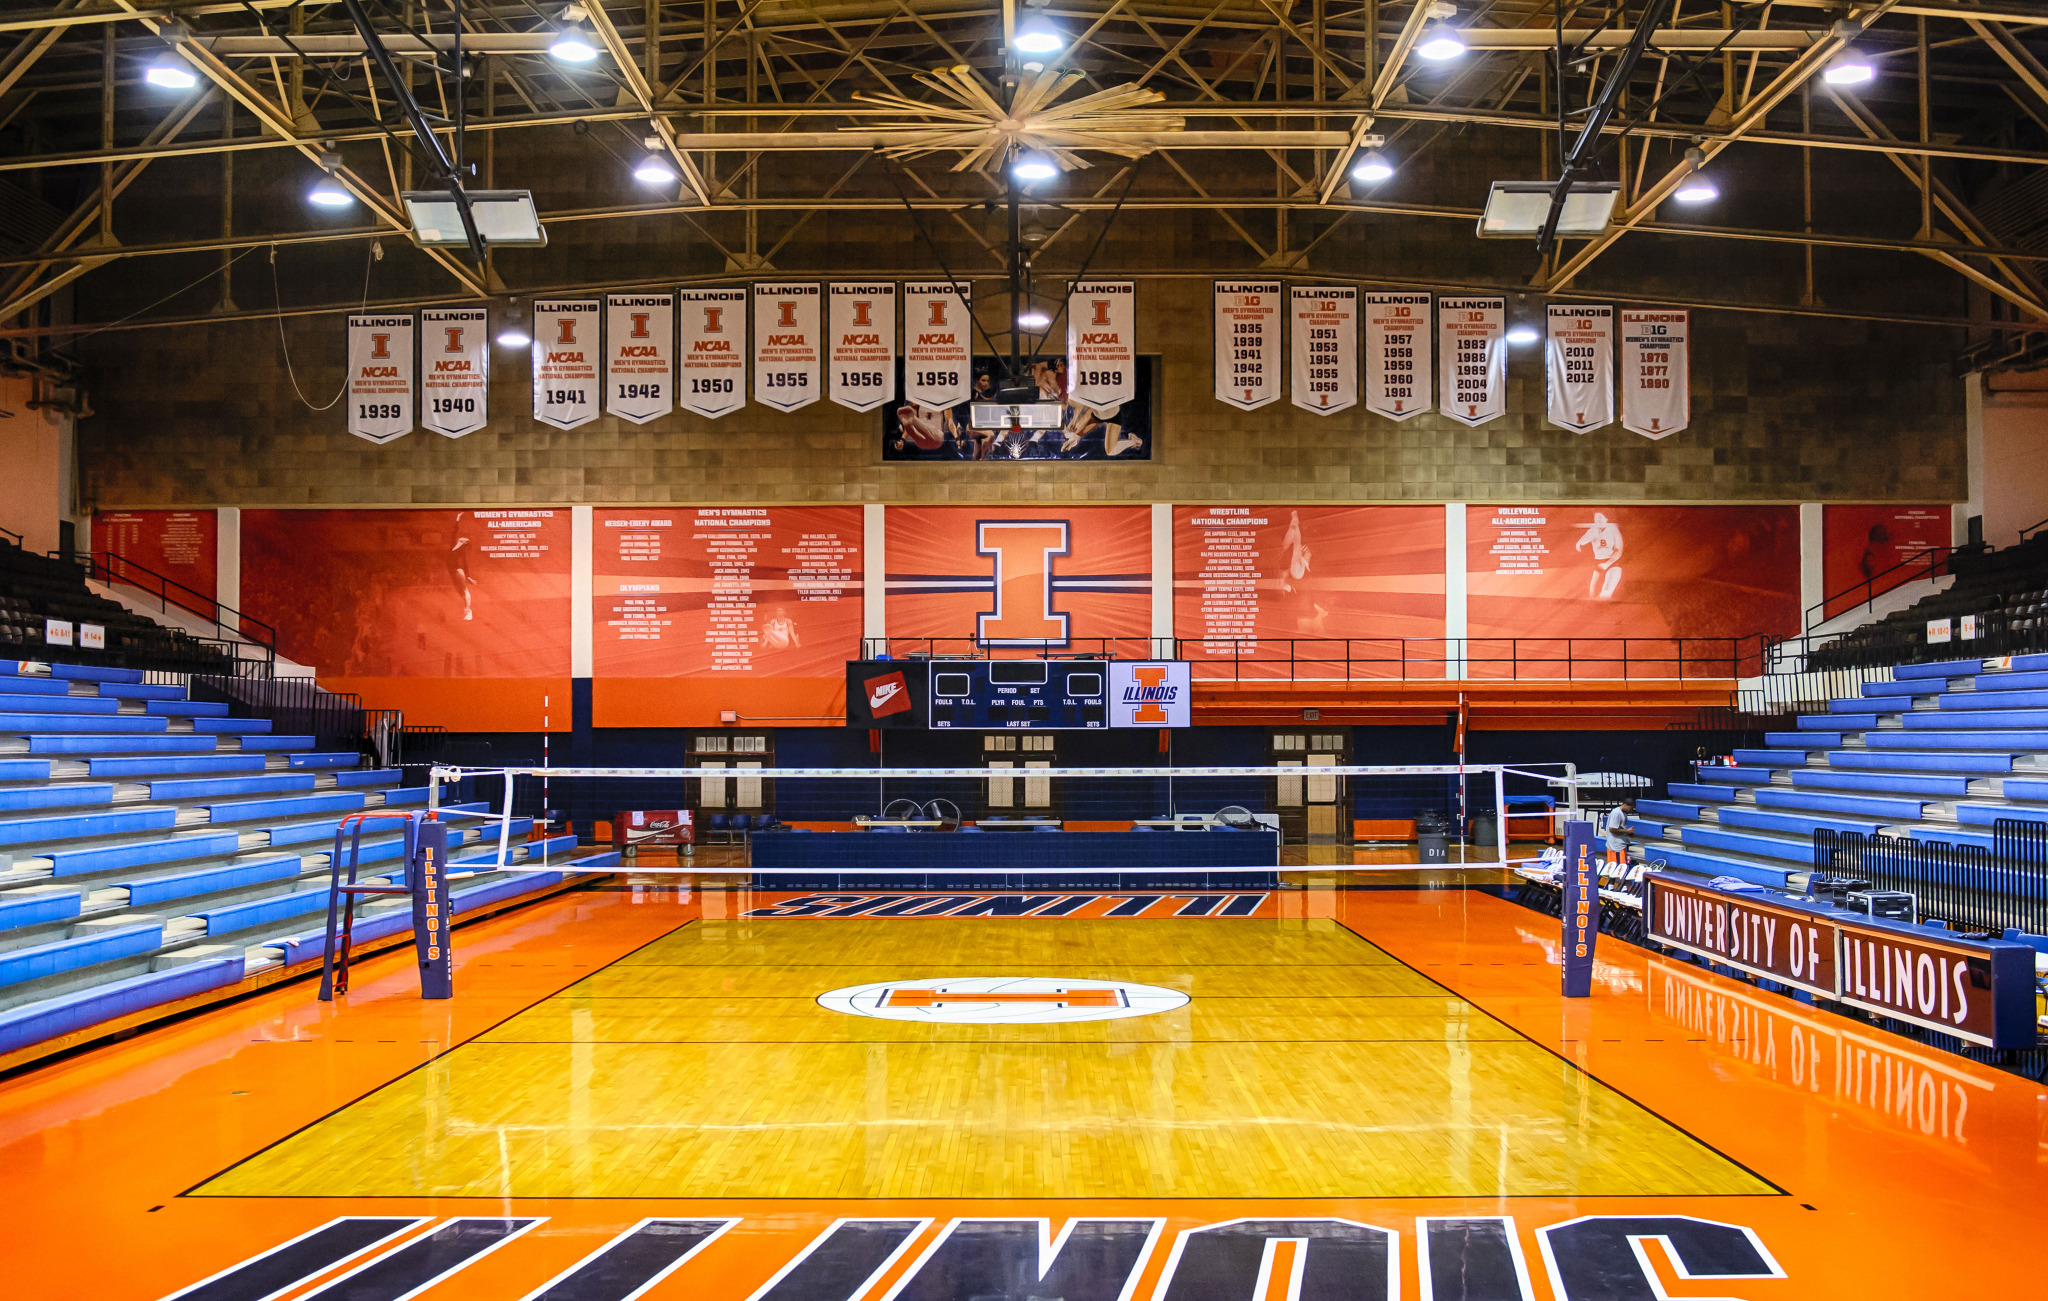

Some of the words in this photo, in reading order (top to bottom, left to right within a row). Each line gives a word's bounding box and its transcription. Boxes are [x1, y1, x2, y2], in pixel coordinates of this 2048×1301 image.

[778, 302, 796, 326] I
[853, 301, 871, 326] I
[929, 300, 947, 326] I
[1092, 300, 1110, 325] I
[704, 308, 722, 332] I
[631, 313, 649, 338] I
[1234, 324, 1262, 333] 1935
[558, 319, 576, 344] I
[1310, 329, 1338, 338] 1951
[445, 328, 463, 352] I
[768, 335, 804, 345] NCAA
[843, 334, 879, 345] NCAA
[918, 334, 955, 344] NCAA
[1082, 334, 1118, 344] NCAA
[1234, 337, 1262, 346] 1939
[1384, 335, 1412, 344] 1957
[372, 334, 390, 358] I
[694, 341, 730, 351] NCAA
[1310, 342, 1338, 352] 1953
[1458, 340, 1486, 349] 1983
[620, 346, 657, 357] NCAA
[1234, 350, 1262, 359] 1941
[1384, 348, 1412, 358] 1958
[1566, 347, 1595, 357] 2010
[548, 352, 584, 363] NCAA
[1310, 355, 1338, 364] 1954
[1458, 353, 1486, 362] 1988
[435, 361, 471, 371] NCAA
[1234, 363, 1262, 373] 1942
[1384, 361, 1412, 370] 1959
[1566, 360, 1595, 370] 2011
[361, 367, 398, 377] NCAA
[1310, 369, 1338, 378] 1955
[1458, 366, 1486, 375] 1989
[766, 373, 807, 387] 1955
[841, 372, 882, 386] 1956
[917, 372, 957, 386] 1958
[1080, 372, 1121, 385] 1989
[1234, 377, 1262, 386] 1950
[1384, 374, 1412, 384] 1960
[1566, 373, 1595, 383] 2012
[692, 379, 733, 393] 1950
[1310, 382, 1338, 391] 1956
[1458, 379, 1487, 389] 2004
[619, 384, 659, 398] 1942
[1384, 388, 1412, 397] 1981
[546, 390, 586, 404] 1941
[1458, 393, 1487, 402] 2009
[433, 399, 474, 413] 1940
[360, 405, 400, 419] 1939
[976, 520, 1070, 648] I
[876, 682, 898, 697] NIKE
[1123, 686, 1178, 701] ILLINOIS
[425, 847, 440, 960] ILLINOIS
[1576, 844, 1589, 958] ILLINOIS
[1664, 891, 1776, 968] UNIVERSITY
[1790, 922, 1820, 981] OF
[1844, 936, 1967, 1025] ILLINOIS
